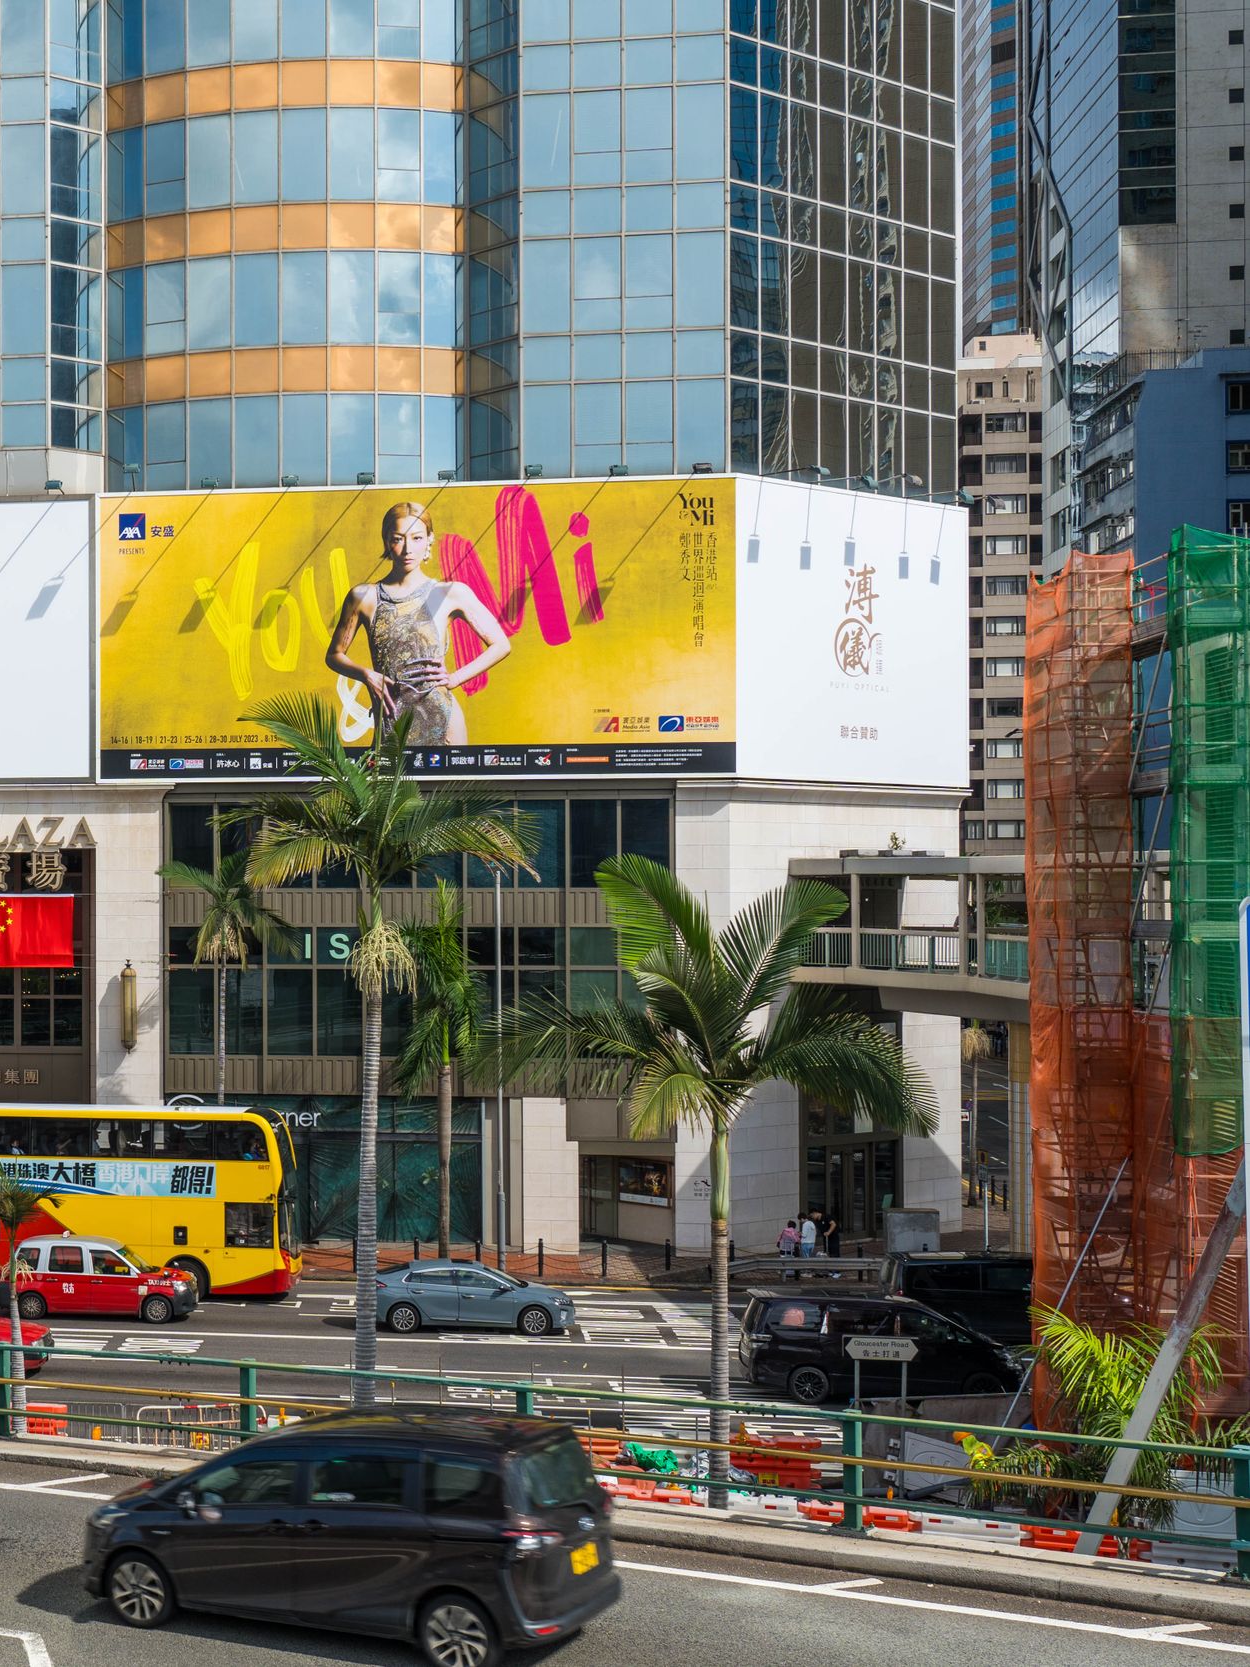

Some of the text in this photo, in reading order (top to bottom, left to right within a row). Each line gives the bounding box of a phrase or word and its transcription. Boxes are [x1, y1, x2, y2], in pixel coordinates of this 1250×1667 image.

[678, 492, 714, 509] You
[690, 509, 715, 526] Mi
[119, 526, 142, 539] AXA
[151, 526, 175, 537] 安盛
[706, 531, 717, 581] 香港站
[439, 485, 604, 697] Mi
[194, 541, 352, 700] You
[135, 736, 153, 744] 18-19
[160, 735, 178, 744] 21-23
[184, 735, 203, 744] 25-26
[209, 735, 227, 743] 28-30
[228, 735, 243, 743] JULY
[244, 735, 258, 743] 2023
[216, 760, 239, 768] 許冰心
[862, 1350, 900, 1358] 告士打道
